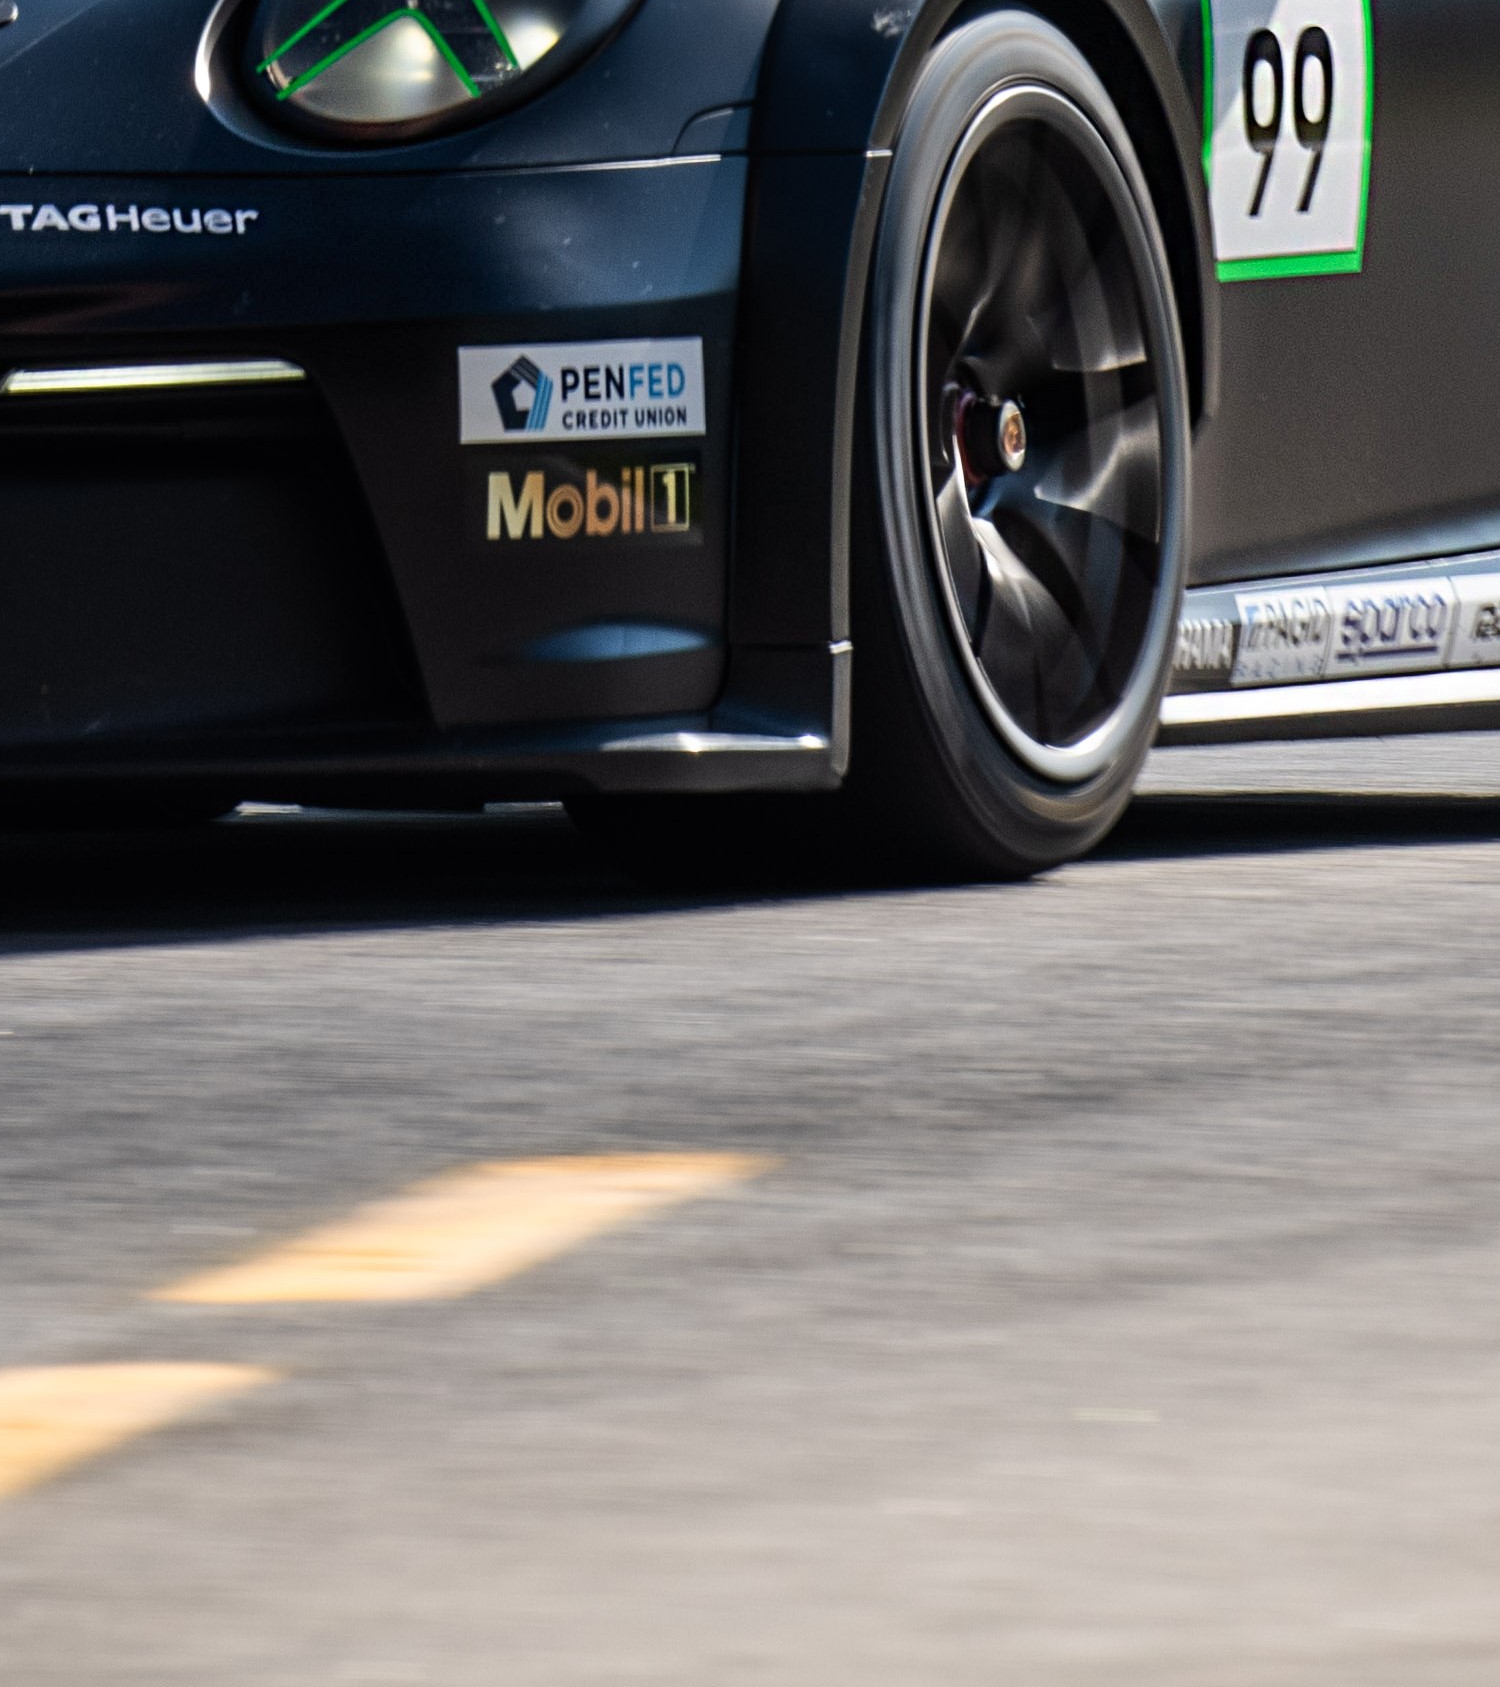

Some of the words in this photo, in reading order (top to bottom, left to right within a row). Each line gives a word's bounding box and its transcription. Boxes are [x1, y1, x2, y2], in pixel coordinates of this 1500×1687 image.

[1243, 25, 1334, 217] 99
[560, 363, 687, 402] PENFED
[561, 409, 629, 431] CREDIT
[634, 405, 688, 429] UNION
[486, 466, 645, 540] Mobil
